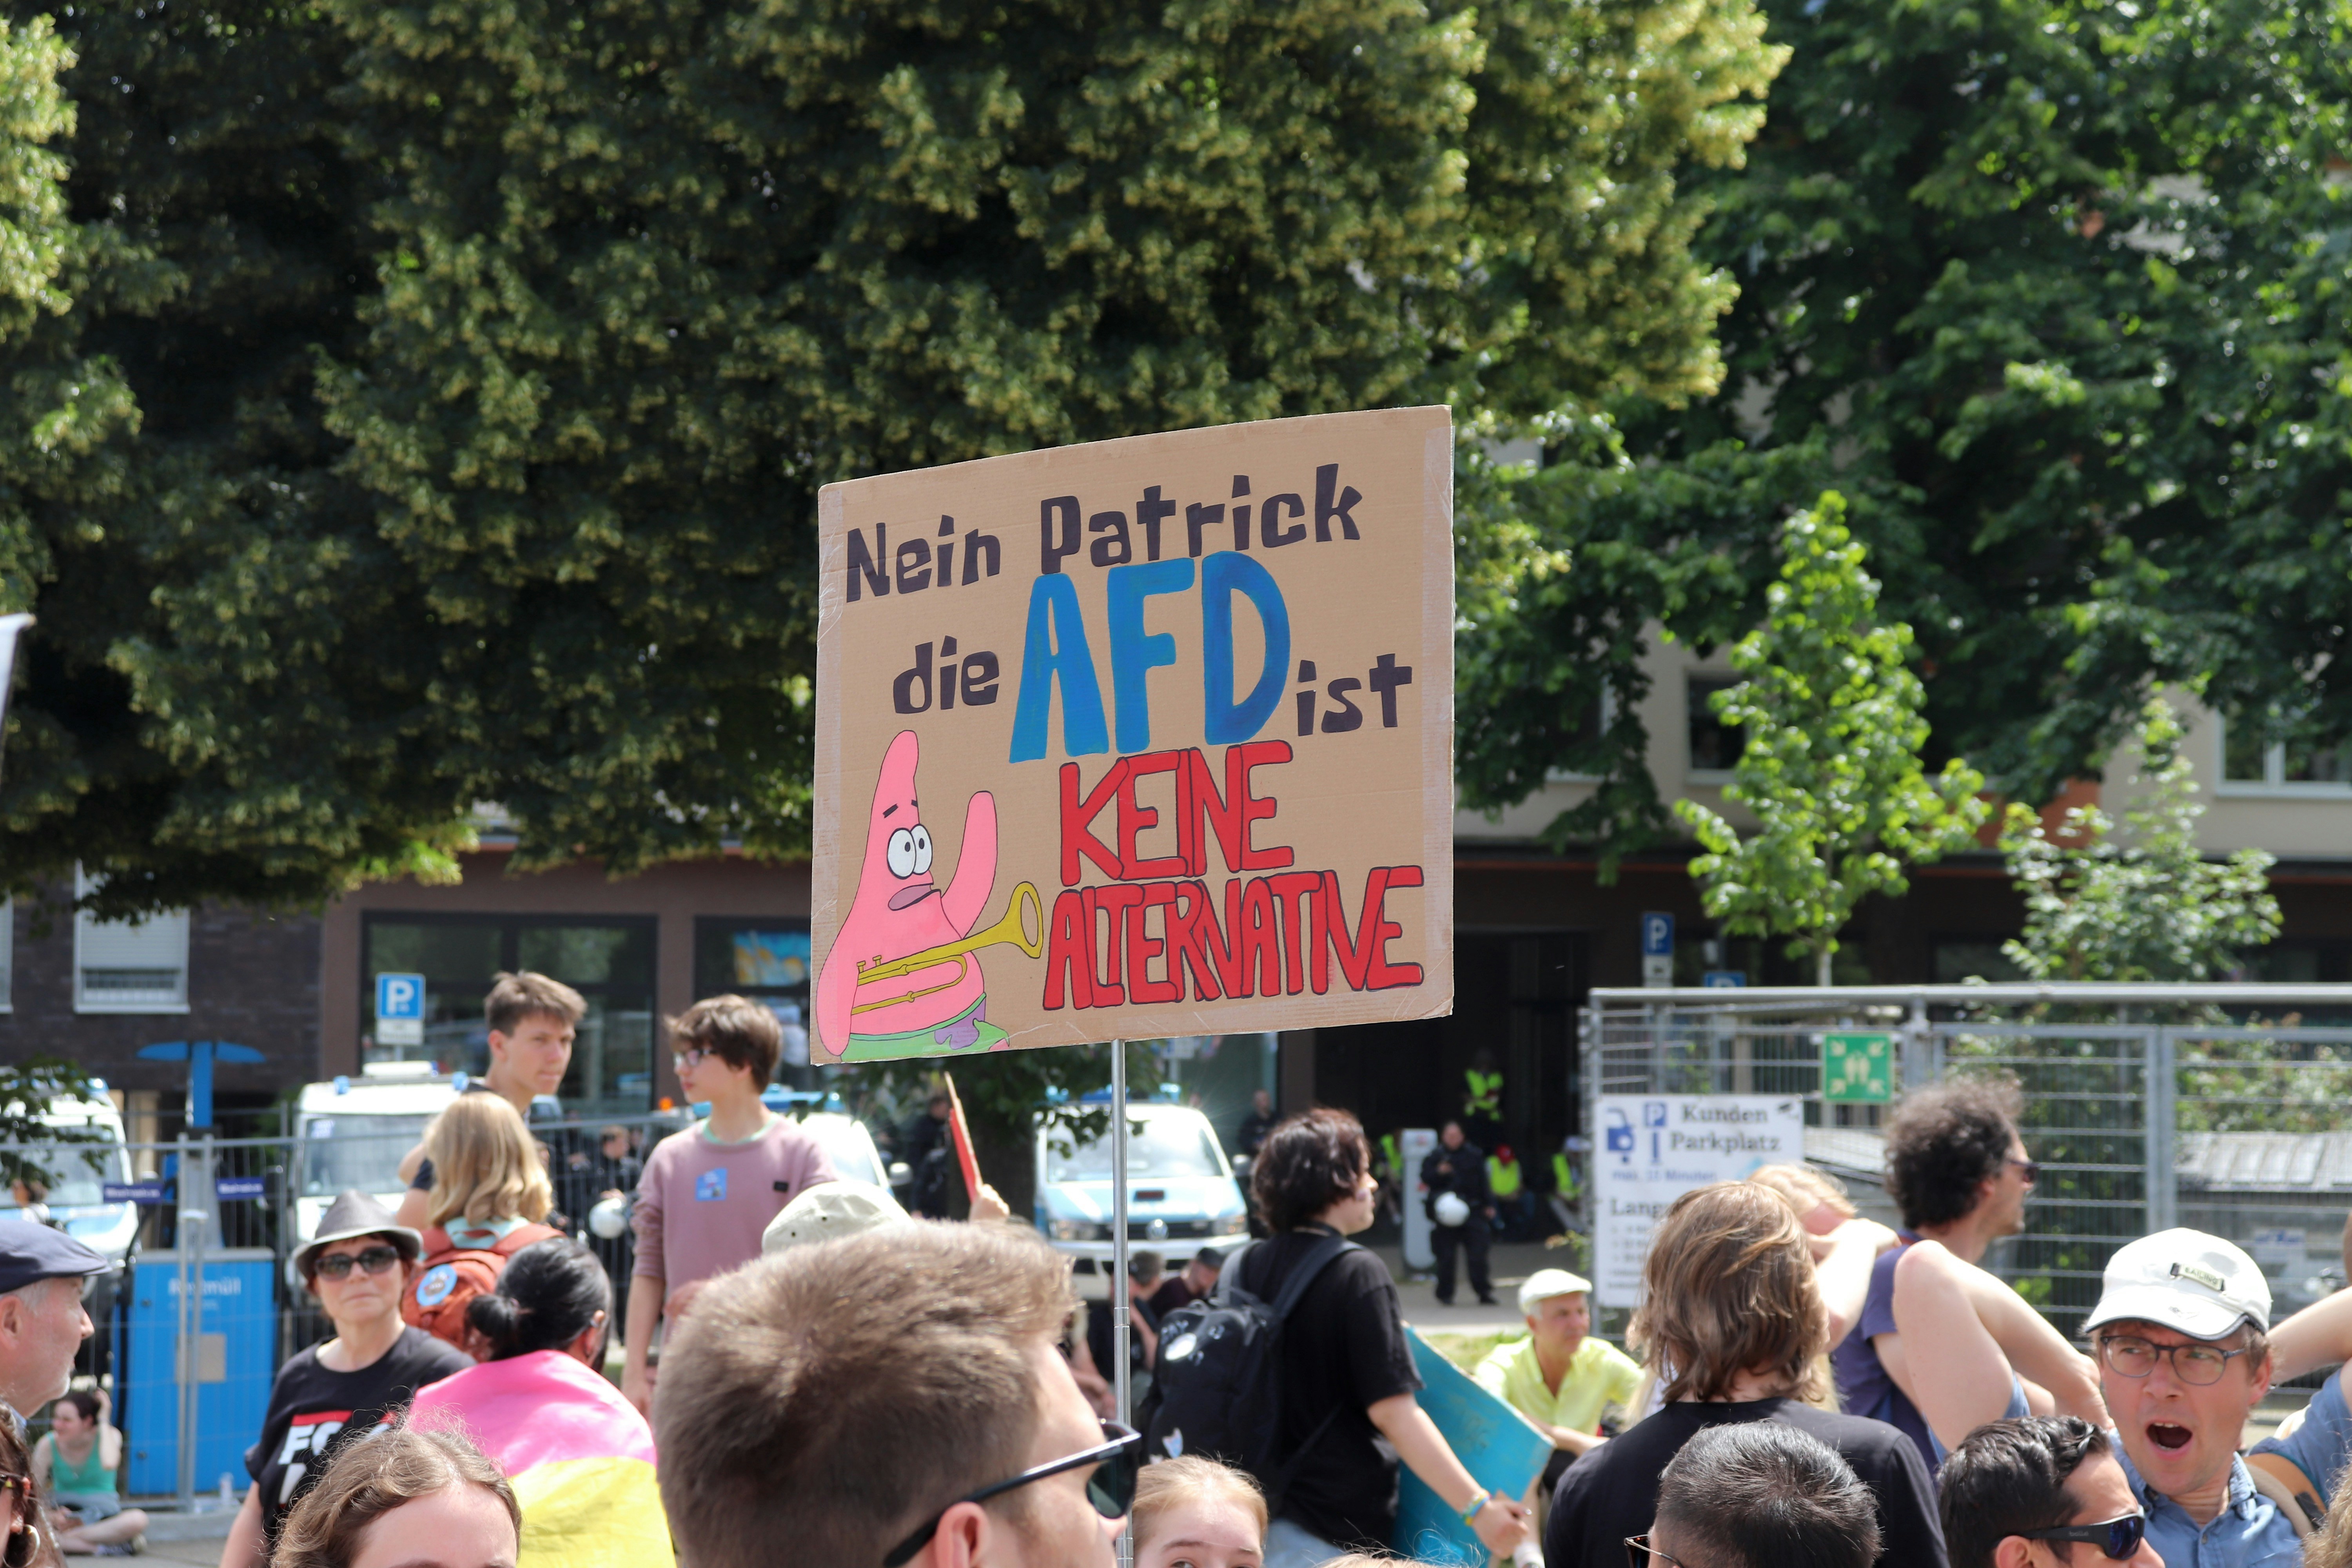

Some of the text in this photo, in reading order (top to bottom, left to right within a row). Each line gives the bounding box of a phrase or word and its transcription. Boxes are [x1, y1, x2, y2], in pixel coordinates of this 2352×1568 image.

[846, 463, 1363, 603] Nein Patrick
[893, 550, 1412, 764] die AFD ist
[1059, 740, 1294, 887] KEINE
[1042, 865, 1425, 1011] ALTERNATIVE
[1649, 918, 1668, 950] P
[387, 980, 414, 1014] P
[1671, 1131, 1782, 1156] Parkplatz
[1682, 1104, 1768, 1123] Kunden
